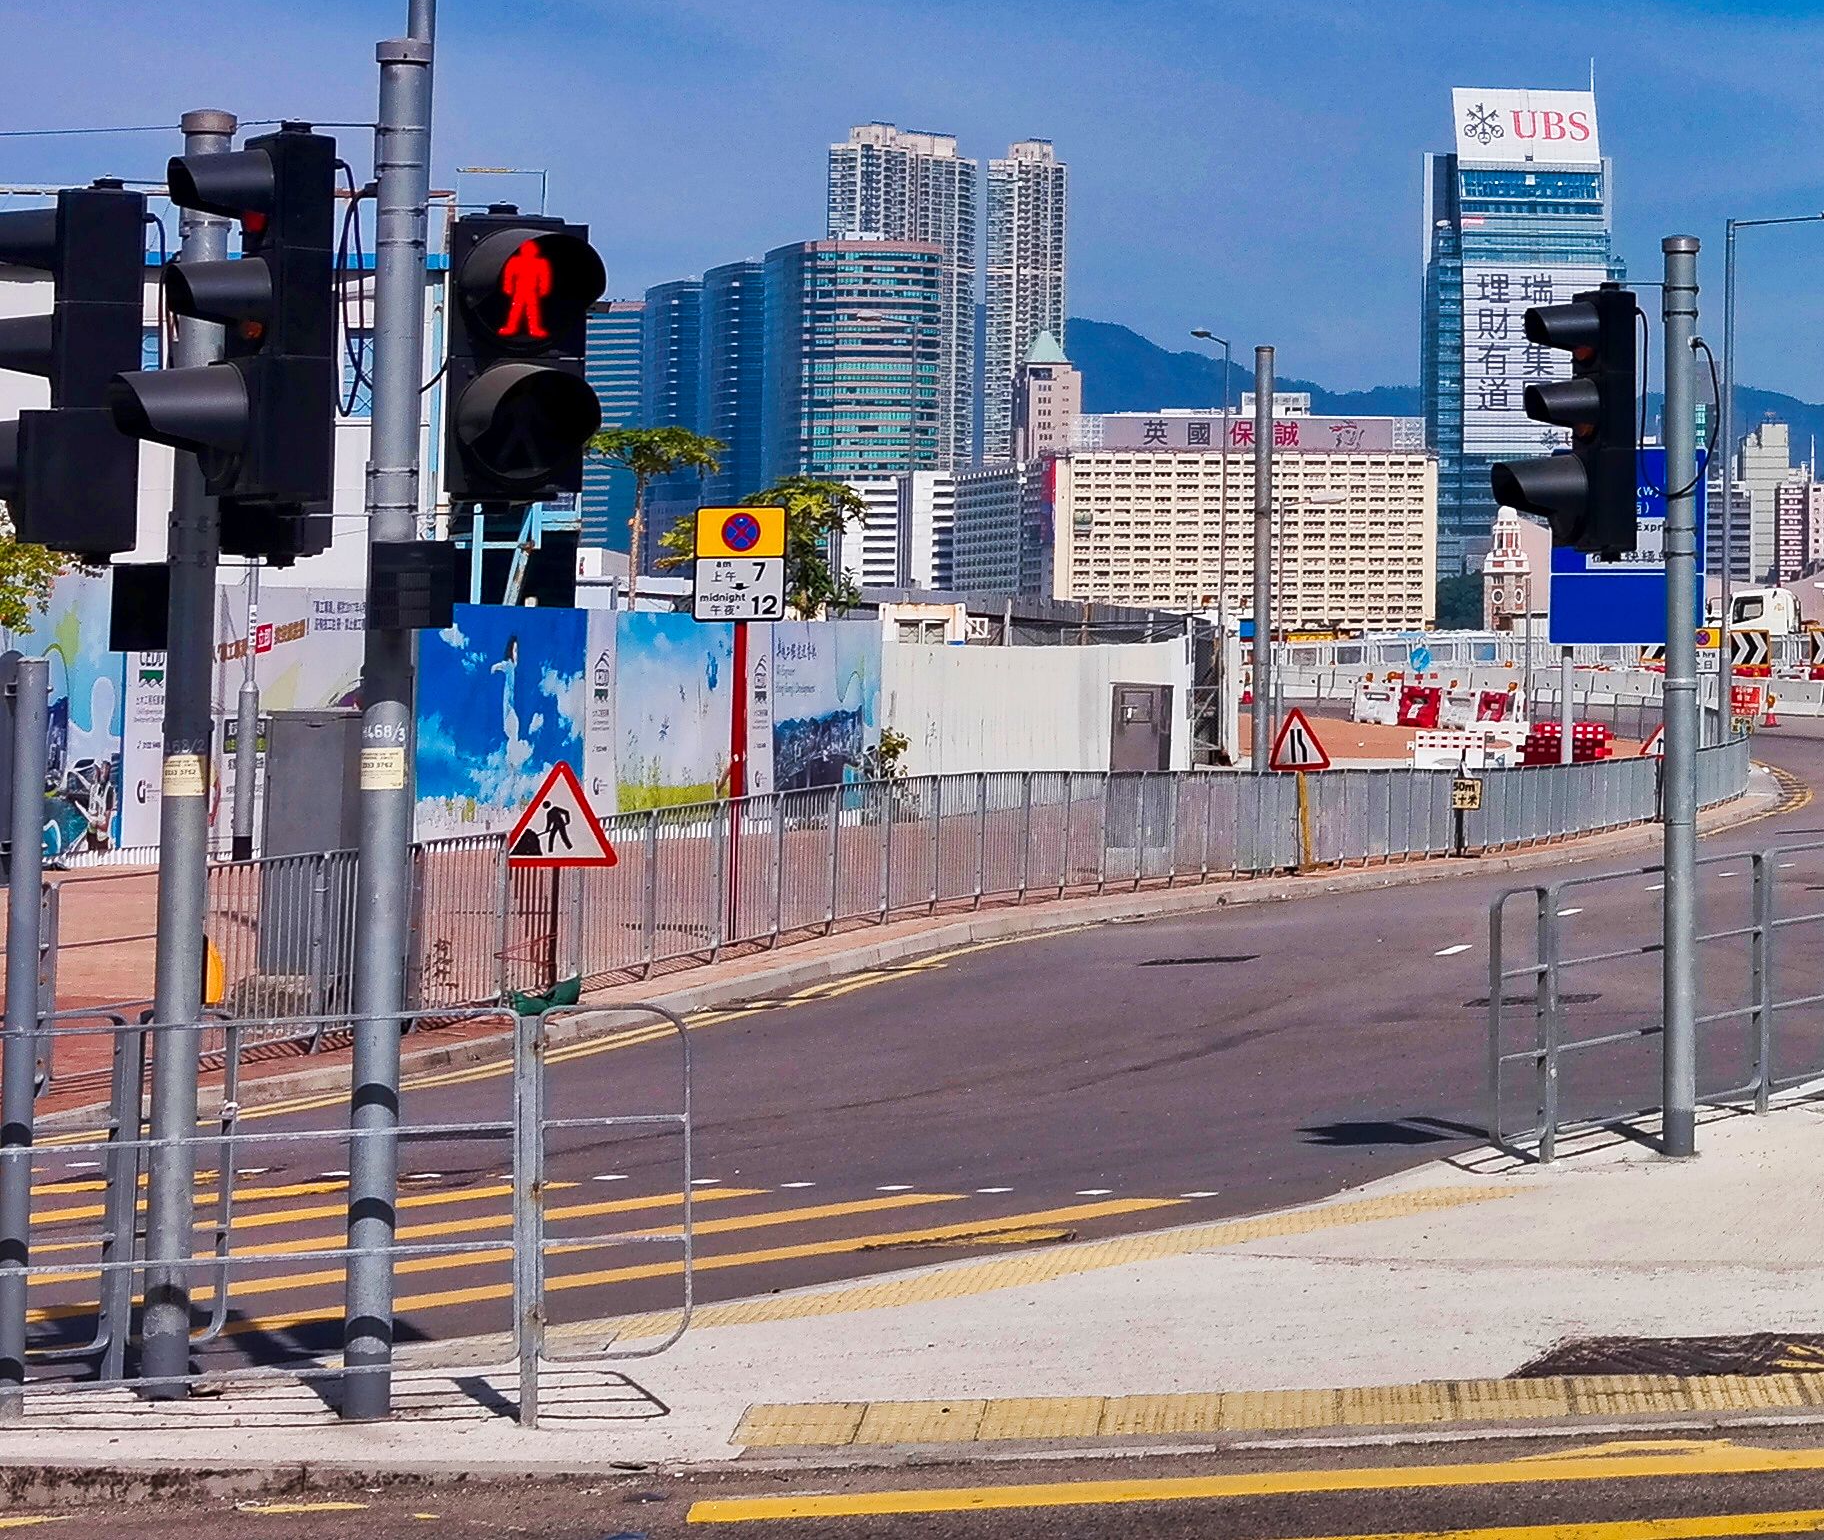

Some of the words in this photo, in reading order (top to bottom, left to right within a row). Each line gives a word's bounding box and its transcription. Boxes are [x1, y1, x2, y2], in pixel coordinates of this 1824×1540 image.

[1511, 110, 1590, 141] UBS
[1476, 273, 1511, 411] 理財有道
[1143, 420, 1299, 446] 英國保誠
[711, 571, 736, 582] 上午
[752, 562, 766, 582] 7
[700, 593, 746, 604] midnight
[751, 595, 778, 615] 12
[1453, 781, 1476, 792] 50m
